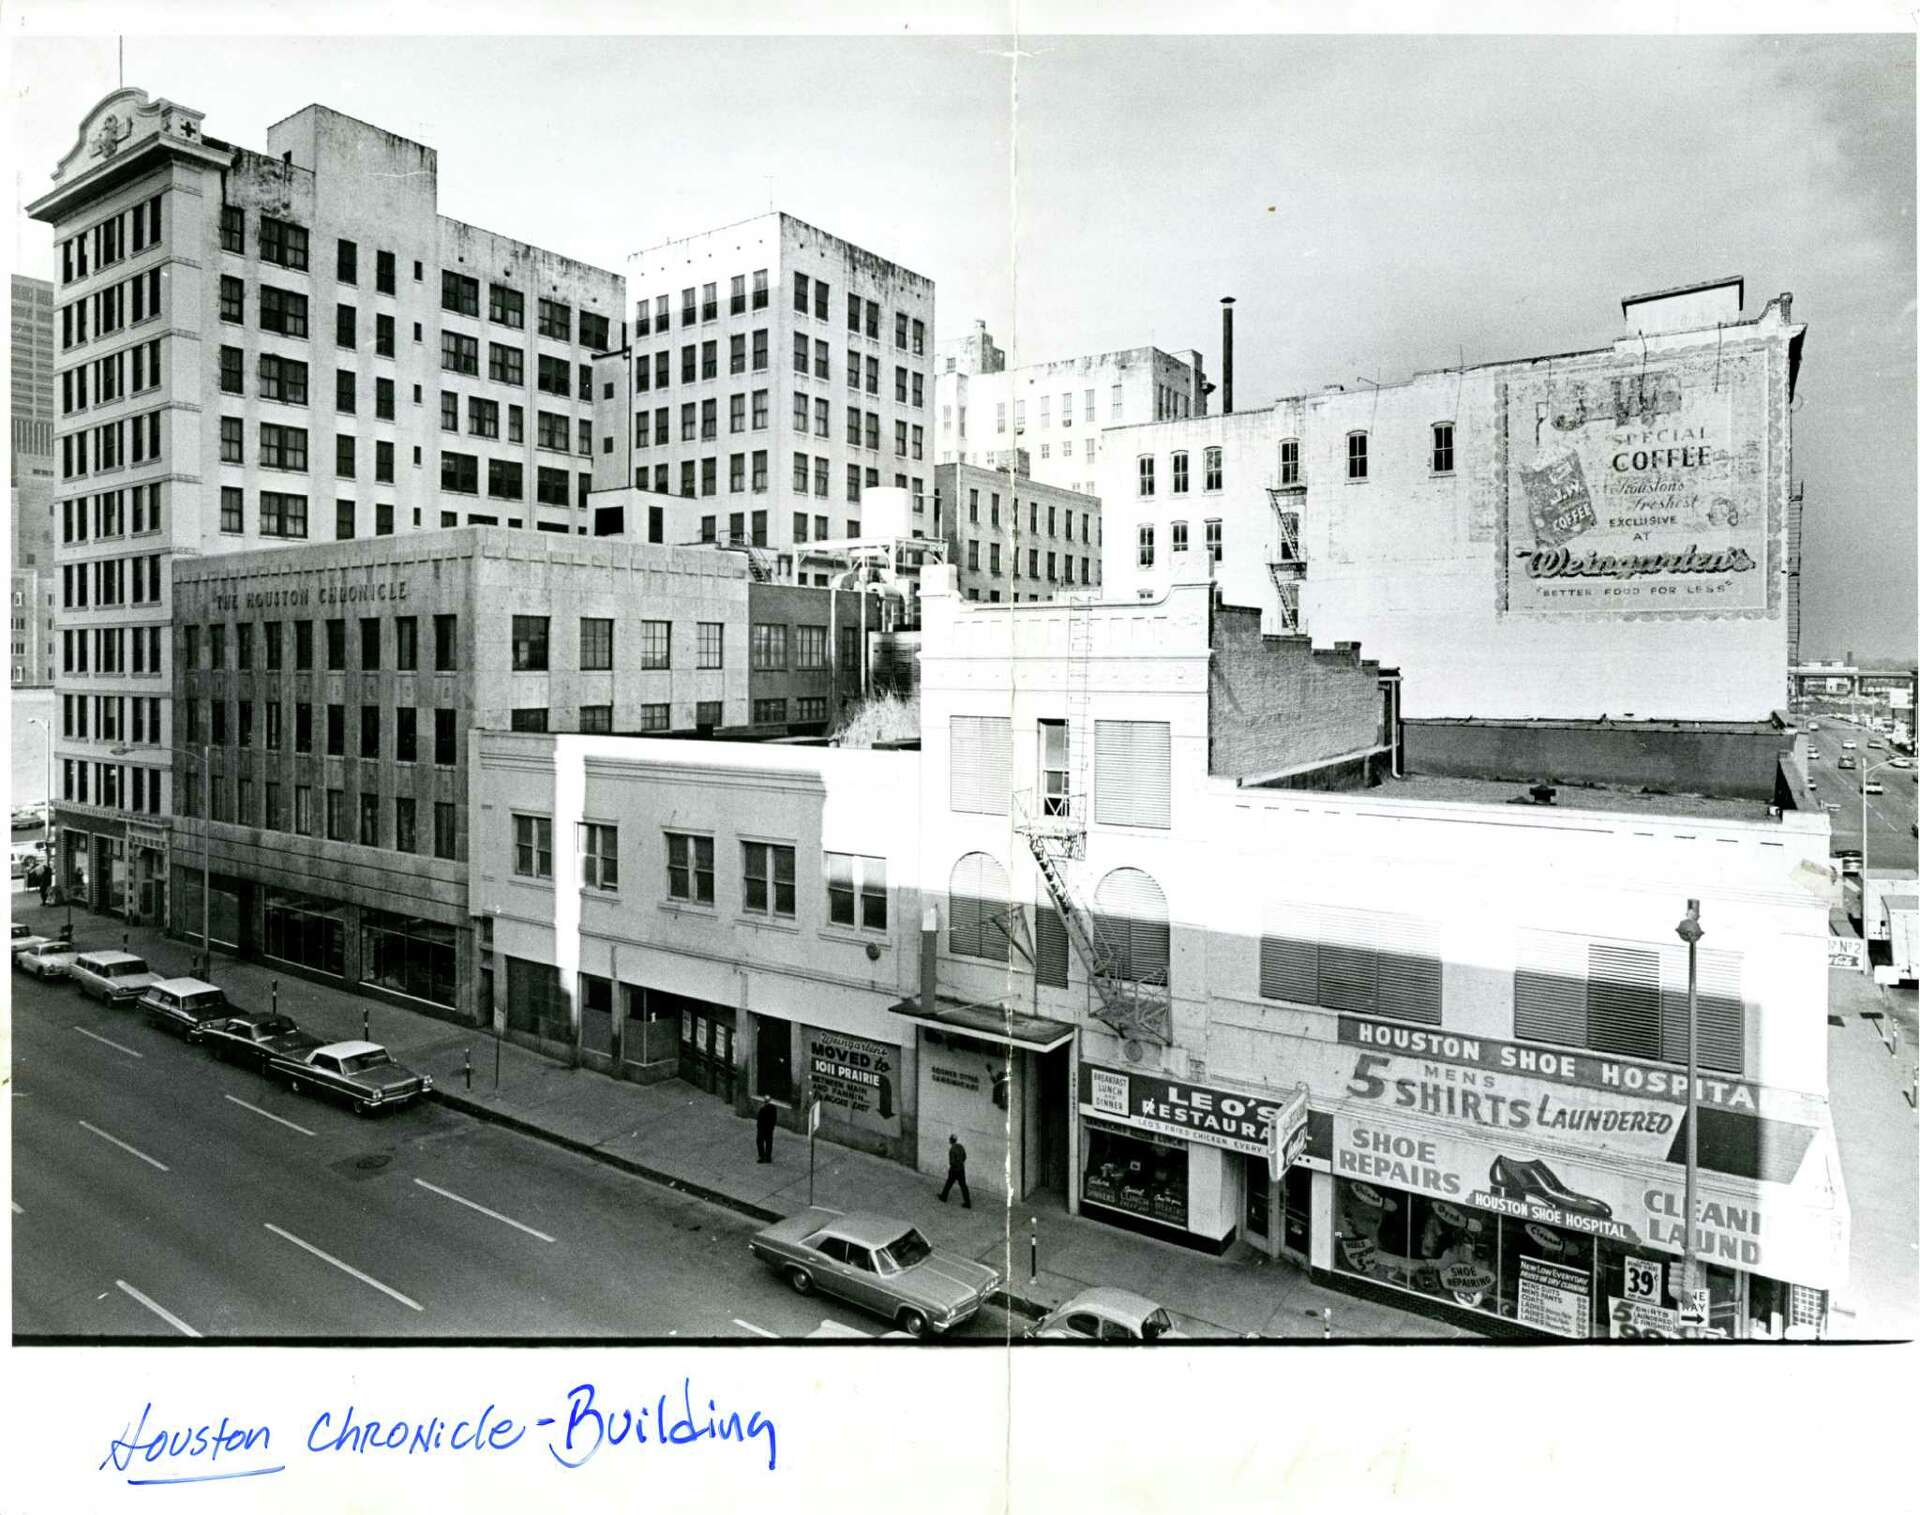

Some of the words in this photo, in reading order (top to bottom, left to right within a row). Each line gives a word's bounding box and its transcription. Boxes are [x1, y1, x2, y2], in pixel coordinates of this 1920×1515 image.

[1612, 444, 1712, 473] COFFEE
[1608, 514, 1679, 528] EXCLUSIVE
[1632, 530, 1651, 543] AT
[217, 594, 238, 611] THE
[246, 588, 309, 610] HOUSTON
[319, 581, 407, 604] CHRONICLE
[1604, 587, 1641, 597] FOOD
[1650, 585, 1677, 596] FOR
[811, 1041, 871, 1068] MOVED
[874, 1056, 892, 1073] to
[1359, 1023, 1480, 1061] HOUSTON
[1501, 1046, 1575, 1078] SHOE
[838, 1066, 881, 1087] PRAIRIE
[1346, 1053, 1391, 1099] 5
[1424, 1064, 1496, 1089] MENS
[1168, 1086, 1278, 1122] LEO'S
[1395, 1078, 1531, 1129] SHIRTS
[1352, 1128, 1437, 1164] SHOE
[1339, 1148, 1461, 1195] REPAIRS
[1475, 1192, 1528, 1217] HOUSTON
[1531, 1206, 1561, 1224] SHOE
[1565, 1213, 1628, 1239] HOSPITAL
[1450, 1266, 1477, 1276] SHOE
[1612, 1301, 1632, 1323] 5
[99, 1402, 272, 1472] Houston
